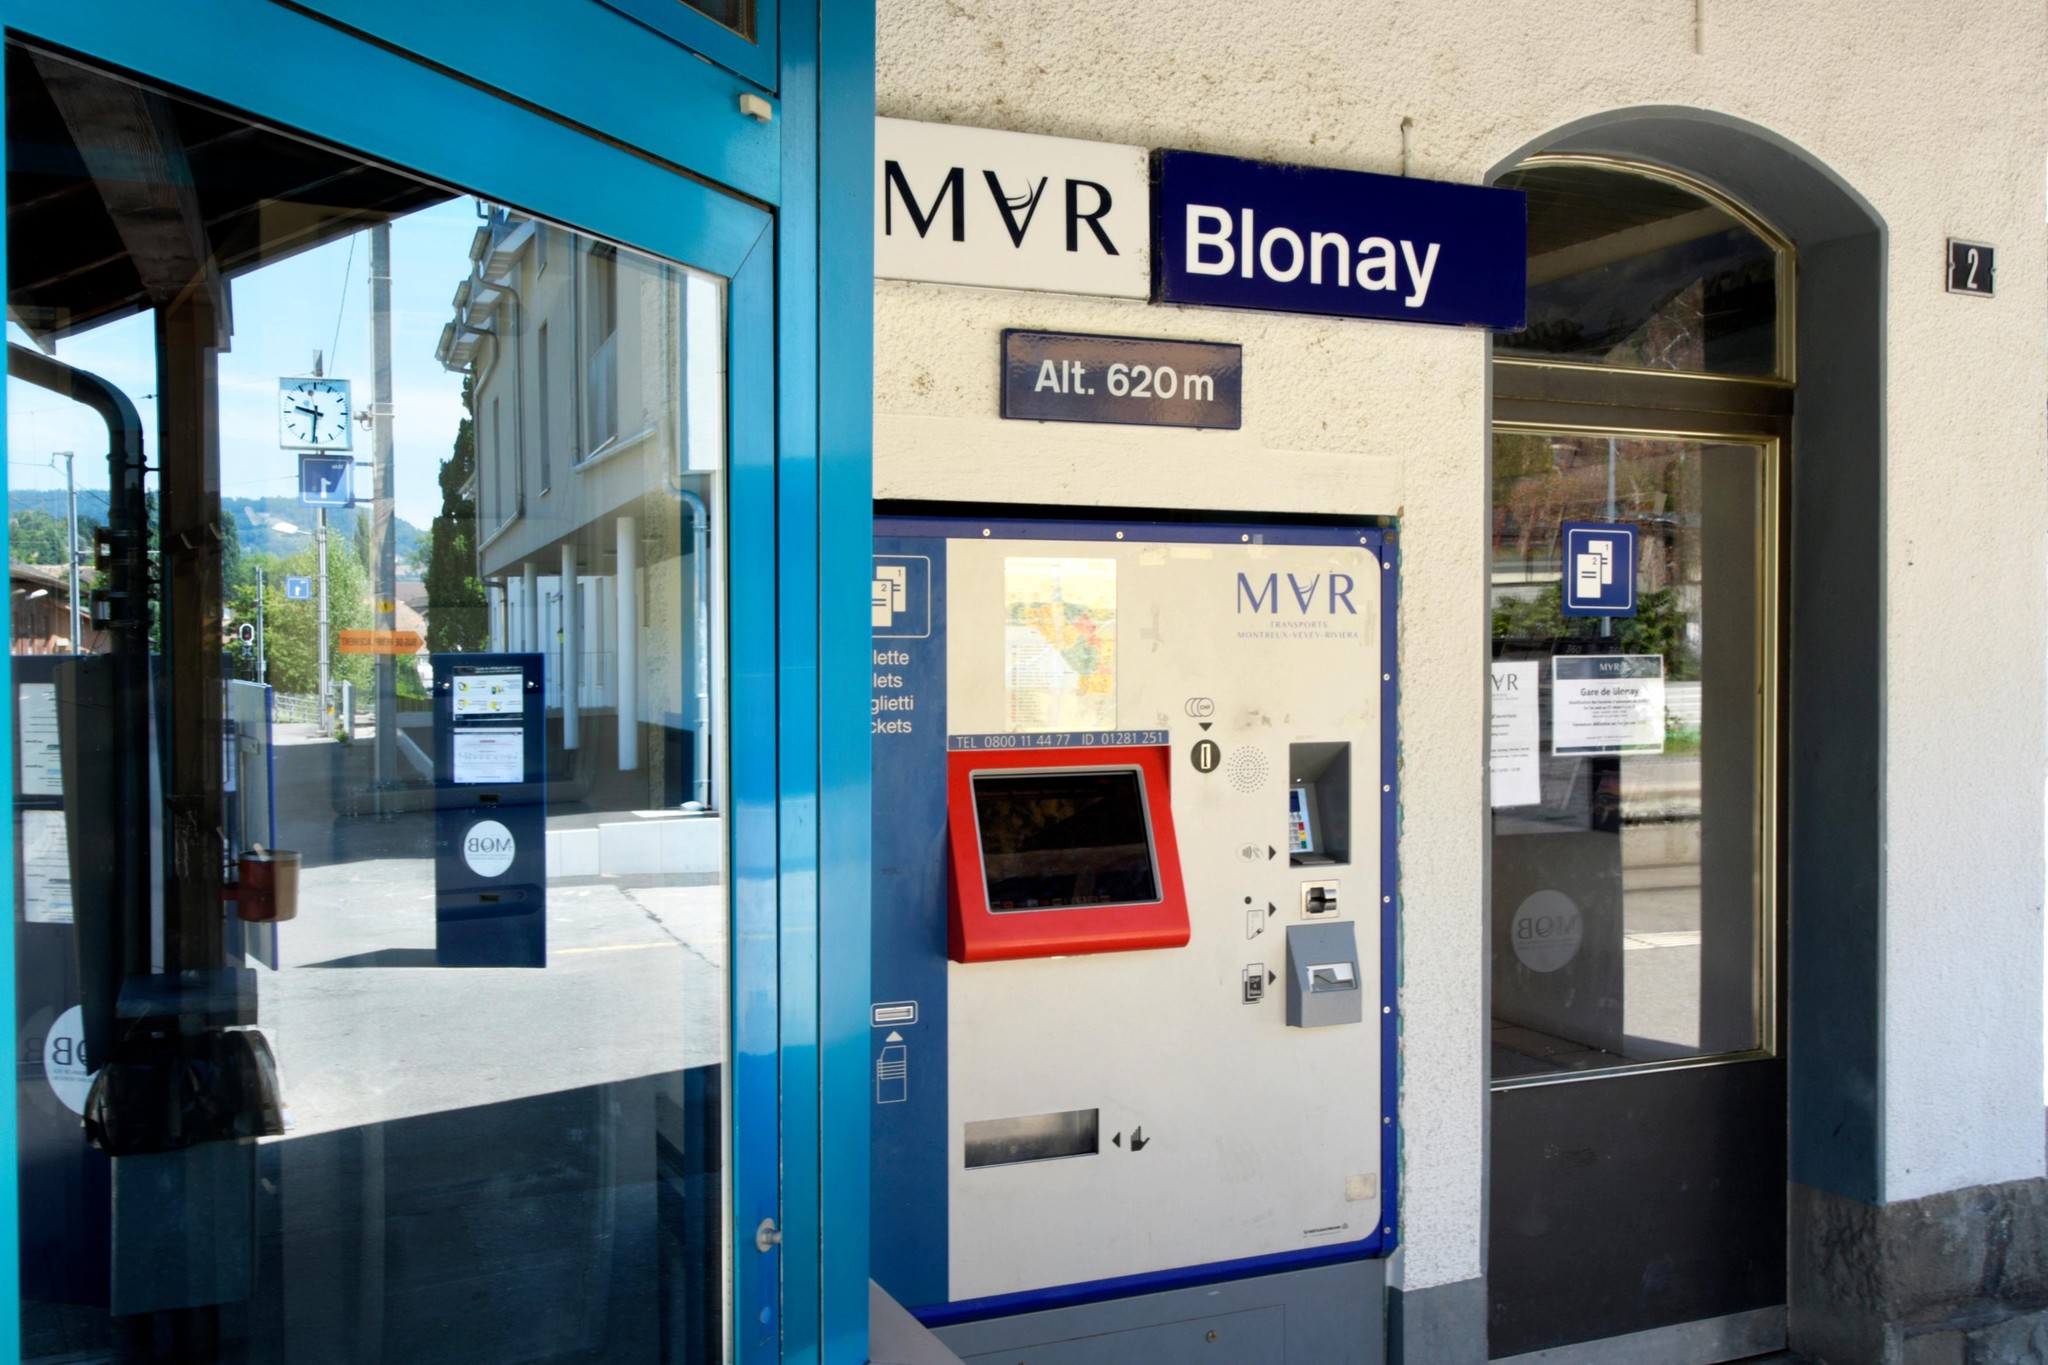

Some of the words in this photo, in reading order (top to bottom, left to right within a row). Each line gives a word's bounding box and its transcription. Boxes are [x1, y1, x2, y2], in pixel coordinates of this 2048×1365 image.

[885, 160, 1120, 256] MVR
[1186, 203, 1441, 308] Blonay
[1966, 248, 1979, 289] 2
[1034, 359, 1095, 395] Alt.
[1605, 543, 1609, 552] 1
[1592, 557, 1598, 566] 2
[897, 569, 902, 577] 1
[881, 583, 888, 592] 2
[1237, 572, 1357, 615] MVR
[1270, 621, 1328, 629] TRANSPORTS
[873, 649, 909, 665] lette
[873, 673, 903, 688] lets
[1491, 673, 1518, 691] VR
[1580, 688, 1599, 696] Gare
[1601, 687, 1611, 696] de
[871, 695, 914, 715] glietti
[871, 718, 912, 734] ckets
[956, 736, 976, 749] TEL
[984, 735, 1016, 748] 0800
[1021, 735, 1031, 747] 11
[1036, 734, 1051, 746] 44
[1056, 734, 1071, 746] 77
[1082, 733, 1094, 745] ID
[1101, 732, 1137, 745] 01281
[1142, 731, 1162, 743] 251
